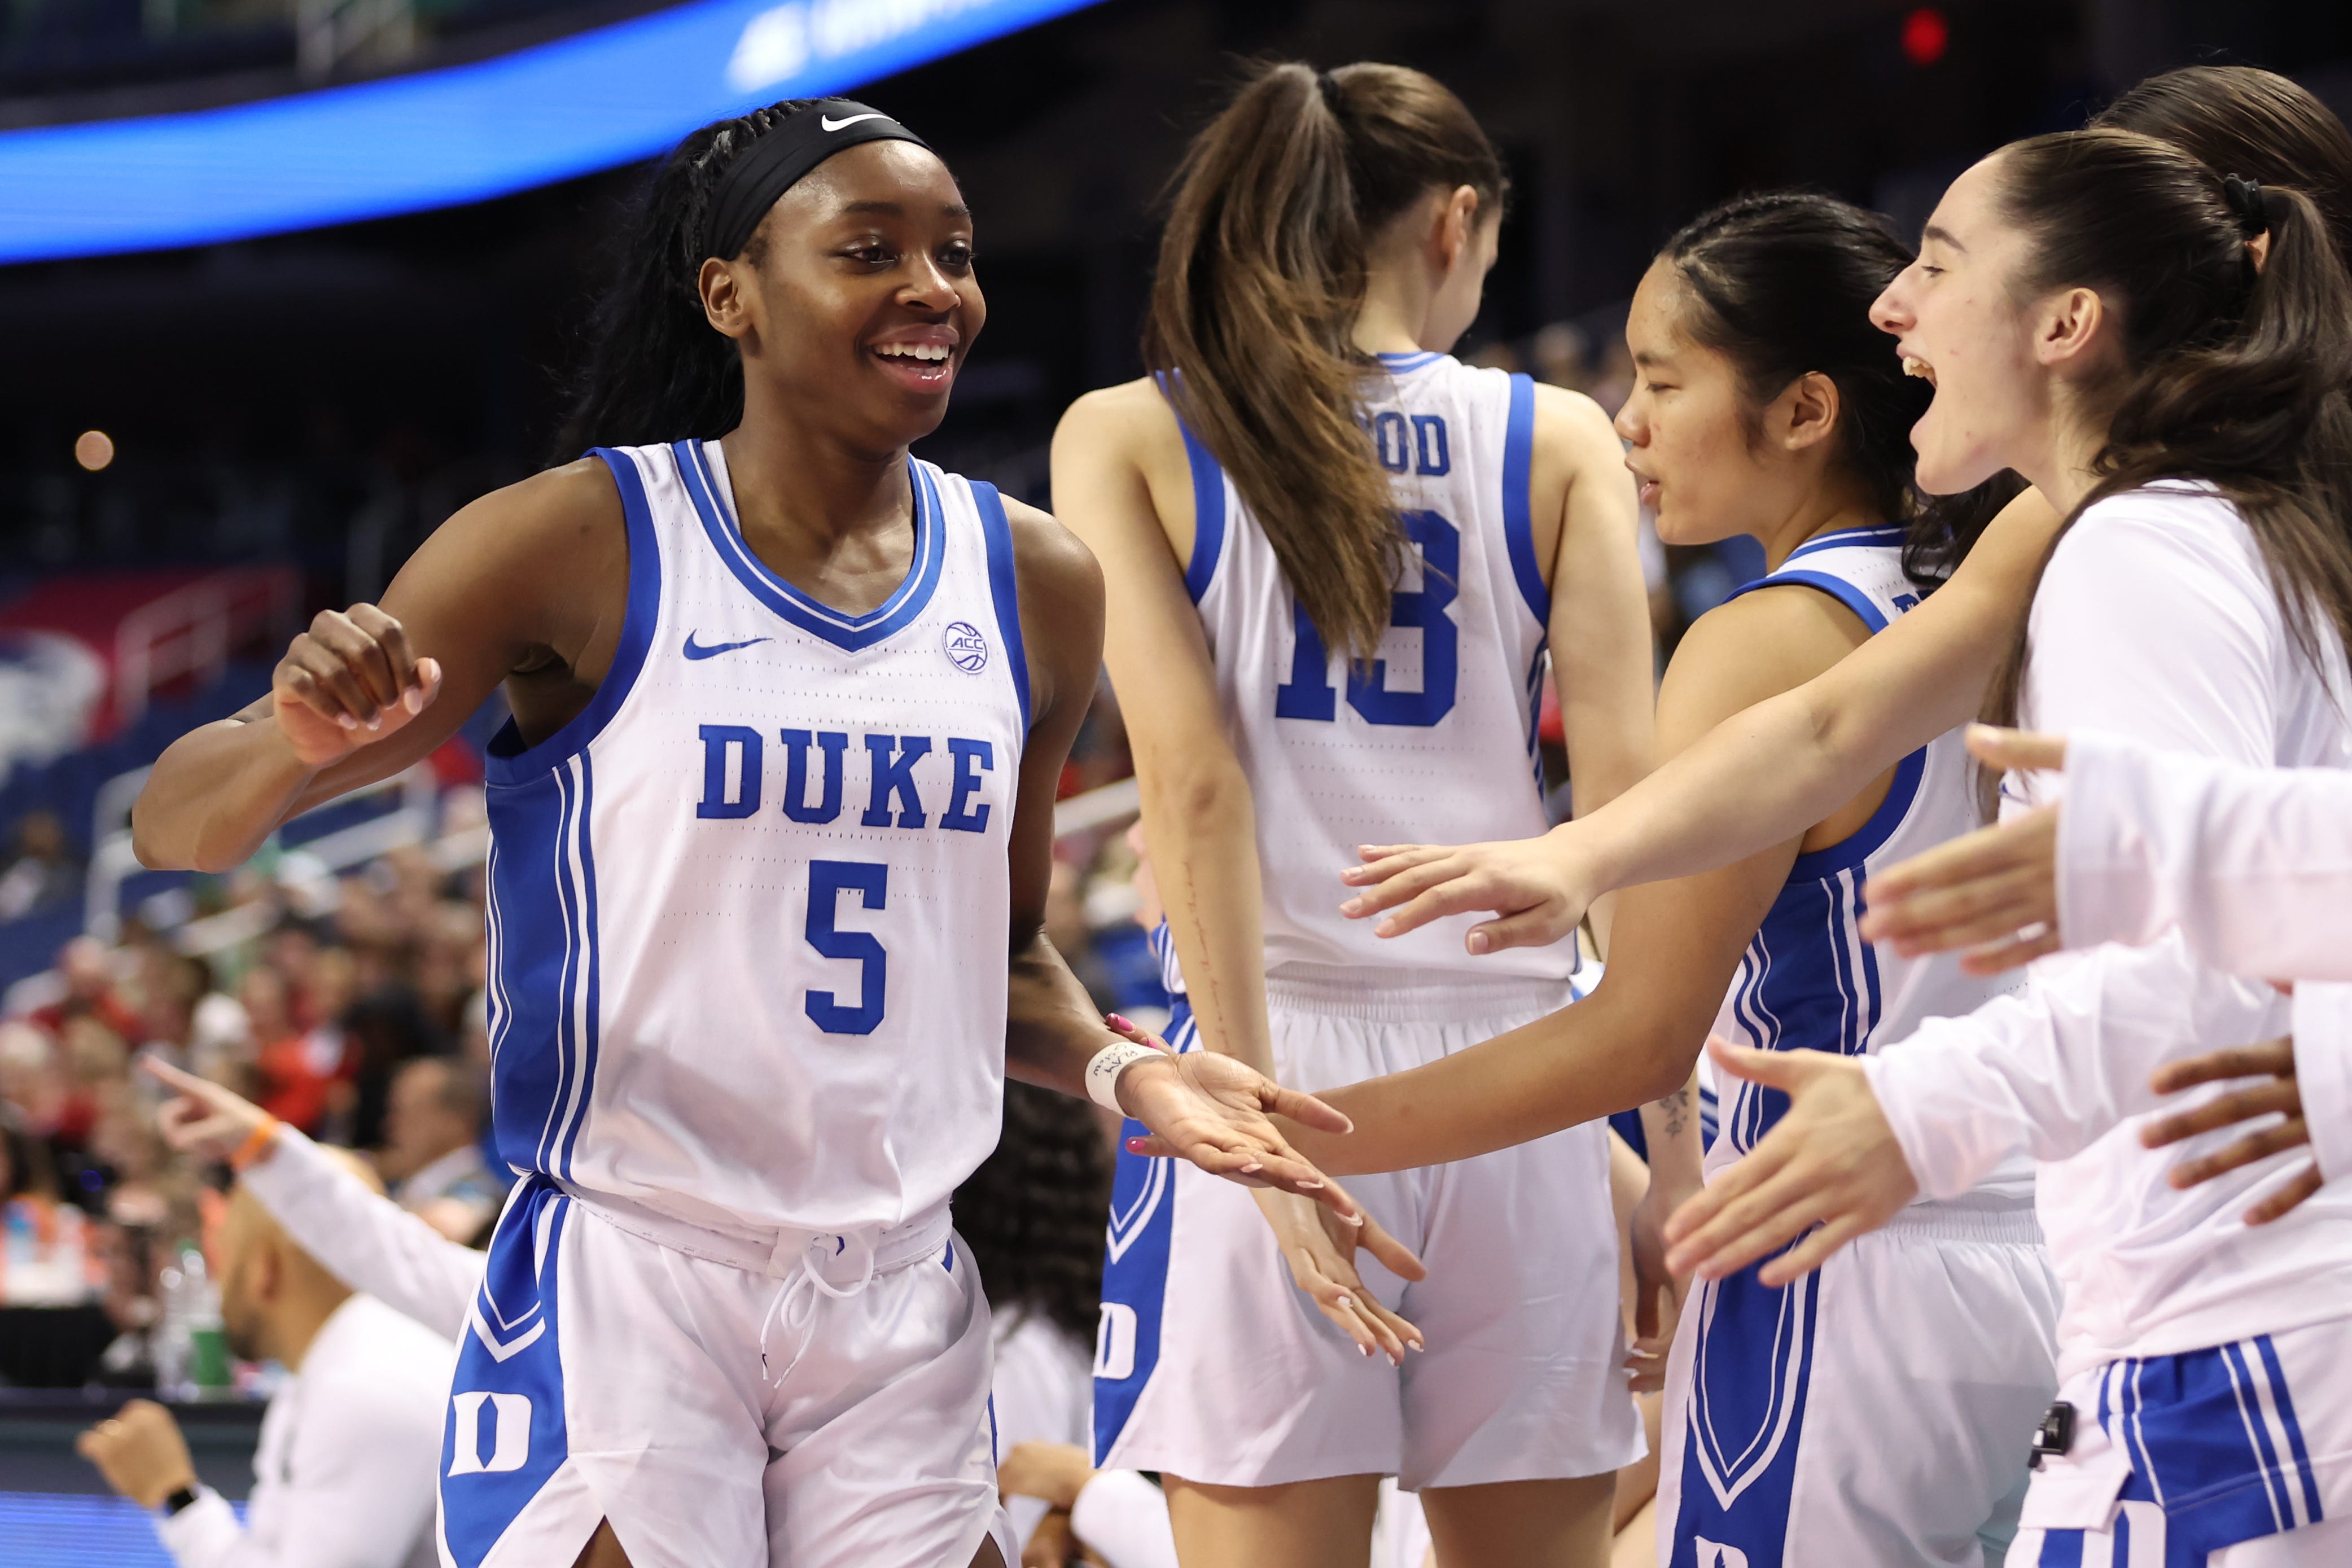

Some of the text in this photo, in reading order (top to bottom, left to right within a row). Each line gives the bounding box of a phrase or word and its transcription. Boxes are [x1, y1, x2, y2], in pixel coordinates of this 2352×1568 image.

[1357, 412, 1450, 477] OD
[951, 637, 983, 650] ACC
[697, 724, 994, 833] DUKE
[805, 860, 888, 1036] 5
[447, 1391, 532, 1478] D
